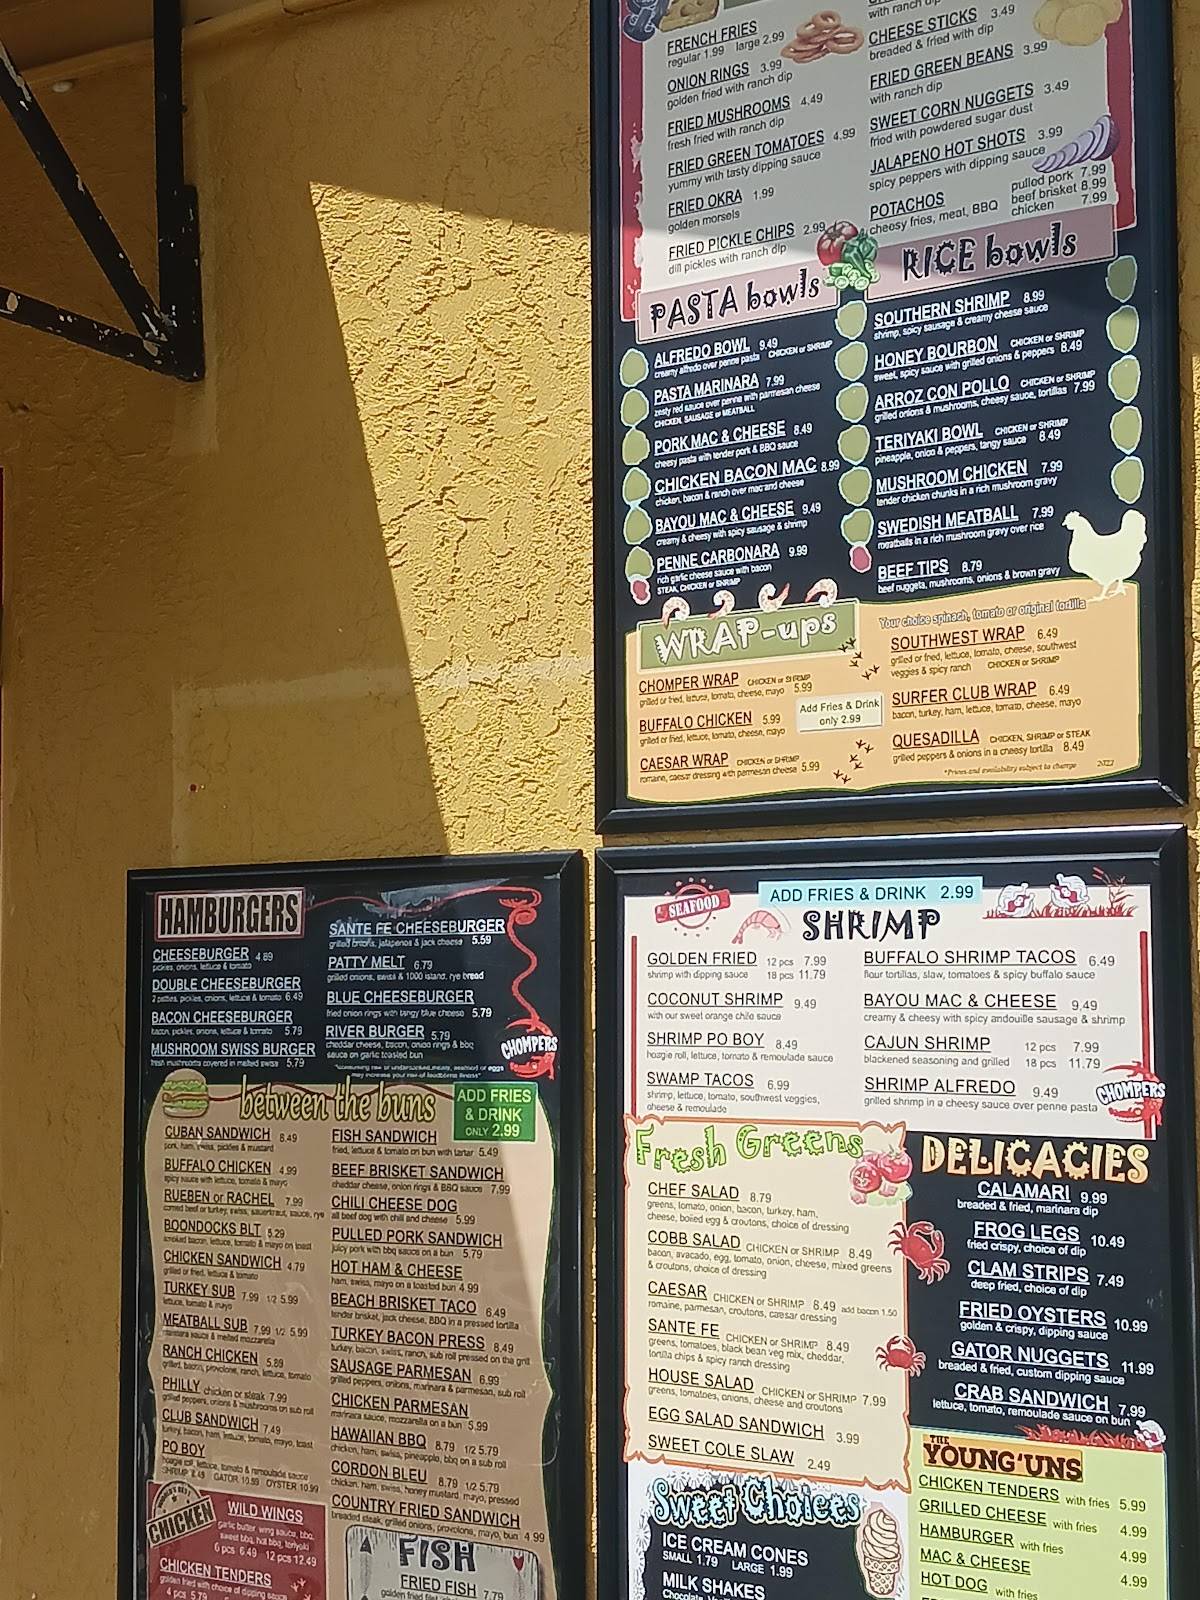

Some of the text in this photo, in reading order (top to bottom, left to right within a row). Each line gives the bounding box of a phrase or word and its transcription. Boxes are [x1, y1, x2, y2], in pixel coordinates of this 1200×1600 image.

[667, 20, 757, 54] FRENCH FRIES
[869, 5, 1015, 46] CHEESE STICKS 3.49
[667, 31, 785, 68] regular 1.99 large 2.99
[667, 60, 782, 93] ONION RINGS 3.99
[870, 41, 1048, 89] FRIED GREEN BEANS 3.99
[870, 80, 1069, 132] SWEET CORN NUGGETS 3.49
[870, 192, 944, 219] POTACHOS
[903, 222, 1077, 282] RICE bowls
[650, 268, 820, 333] PASTA bowls
[874, 290, 1045, 328] SOUTHERN SHRIMP 8.99
[655, 337, 778, 365] ALFREDO BOWL 9.49
[655, 457, 840, 493] CHICKEN BACON MAC 8.99
[878, 505, 1054, 536] SWEDISH MEATBALL 7.99
[657, 543, 808, 571] PENNE CARBONARA 9.99
[878, 559, 983, 580] BEEF TIPS 8.79
[655, 613, 837, 664] WRAP-ups
[890, 625, 1058, 651] SOUTHWEST WRAP 6.49
[799, 699, 880, 714] Add Fries & Drink
[892, 682, 1070, 706] SURFER CLUB WRAP 6.49
[668, 895, 720, 918] SEAFOOD
[770, 885, 974, 902] ADD FRIES & DRINK 2.99
[160, 894, 299, 935] HAMBURGERS
[803, 909, 940, 942] SHRIMP
[152, 947, 249, 960] CHEESEBURGER
[328, 955, 433, 970] PATTY MELT 6.79
[647, 952, 826, 969] GOLDEN FRIED 12 pcs 7.99
[864, 949, 1115, 968] BUFFALO SHRIMP TACOS 6.49
[152, 977, 301, 991] DOUBLE CHEESEBURGER
[501, 1036, 558, 1059] CHOMPERS
[864, 1035, 1099, 1054] CAJUN SHRIMP 12 pcs 7.99
[240, 1074, 436, 1122] between the buns
[459, 1089, 531, 1103] ADD FRIES
[1096, 1080, 1166, 1105] CHOMPERS
[465, 1108, 522, 1122] & DRINK
[465, 1124, 520, 1138] ONLY 2.99
[635, 1124, 864, 1173] Fresh Greens
[922, 1135, 1149, 1183] DELICACIES
[165, 1159, 271, 1174] BUFFALO CHICKEN
[332, 1164, 504, 1180] BEEF BRISKET SANDWICH
[648, 1182, 772, 1203] CHEF SALAD 8.79
[977, 1181, 1108, 1204] CALAMARI 9.99
[957, 1199, 1099, 1218] breaded & fried, marinara dip
[974, 1221, 1125, 1248] FROG LEGS 10.49
[967, 1260, 1124, 1287] CLAM STRIPS 7.49
[951, 1341, 1154, 1375] GATOR NUGGETS 11.99
[162, 1409, 259, 1431] CLUB SANDWICH
[648, 1406, 860, 1444] EGG SALAD SANDWICH 3.99
[331, 1426, 455, 1453] HAWAIIAN BBQ 8.79
[930, 1435, 951, 1446] THE
[924, 1443, 1082, 1482] YOUNG'UNS
[653, 1475, 861, 1526] Sweet Choices
[919, 1475, 1146, 1512] CHICKEN TENDERS with fries 5.99
[147, 1502, 215, 1546] CHICKEN
[400, 1537, 476, 1572] FISH
[663, 1532, 809, 1567] ICE CREAM CONES
[663, 1551, 793, 1578] SMALL 1.79 LARGE 1.99
